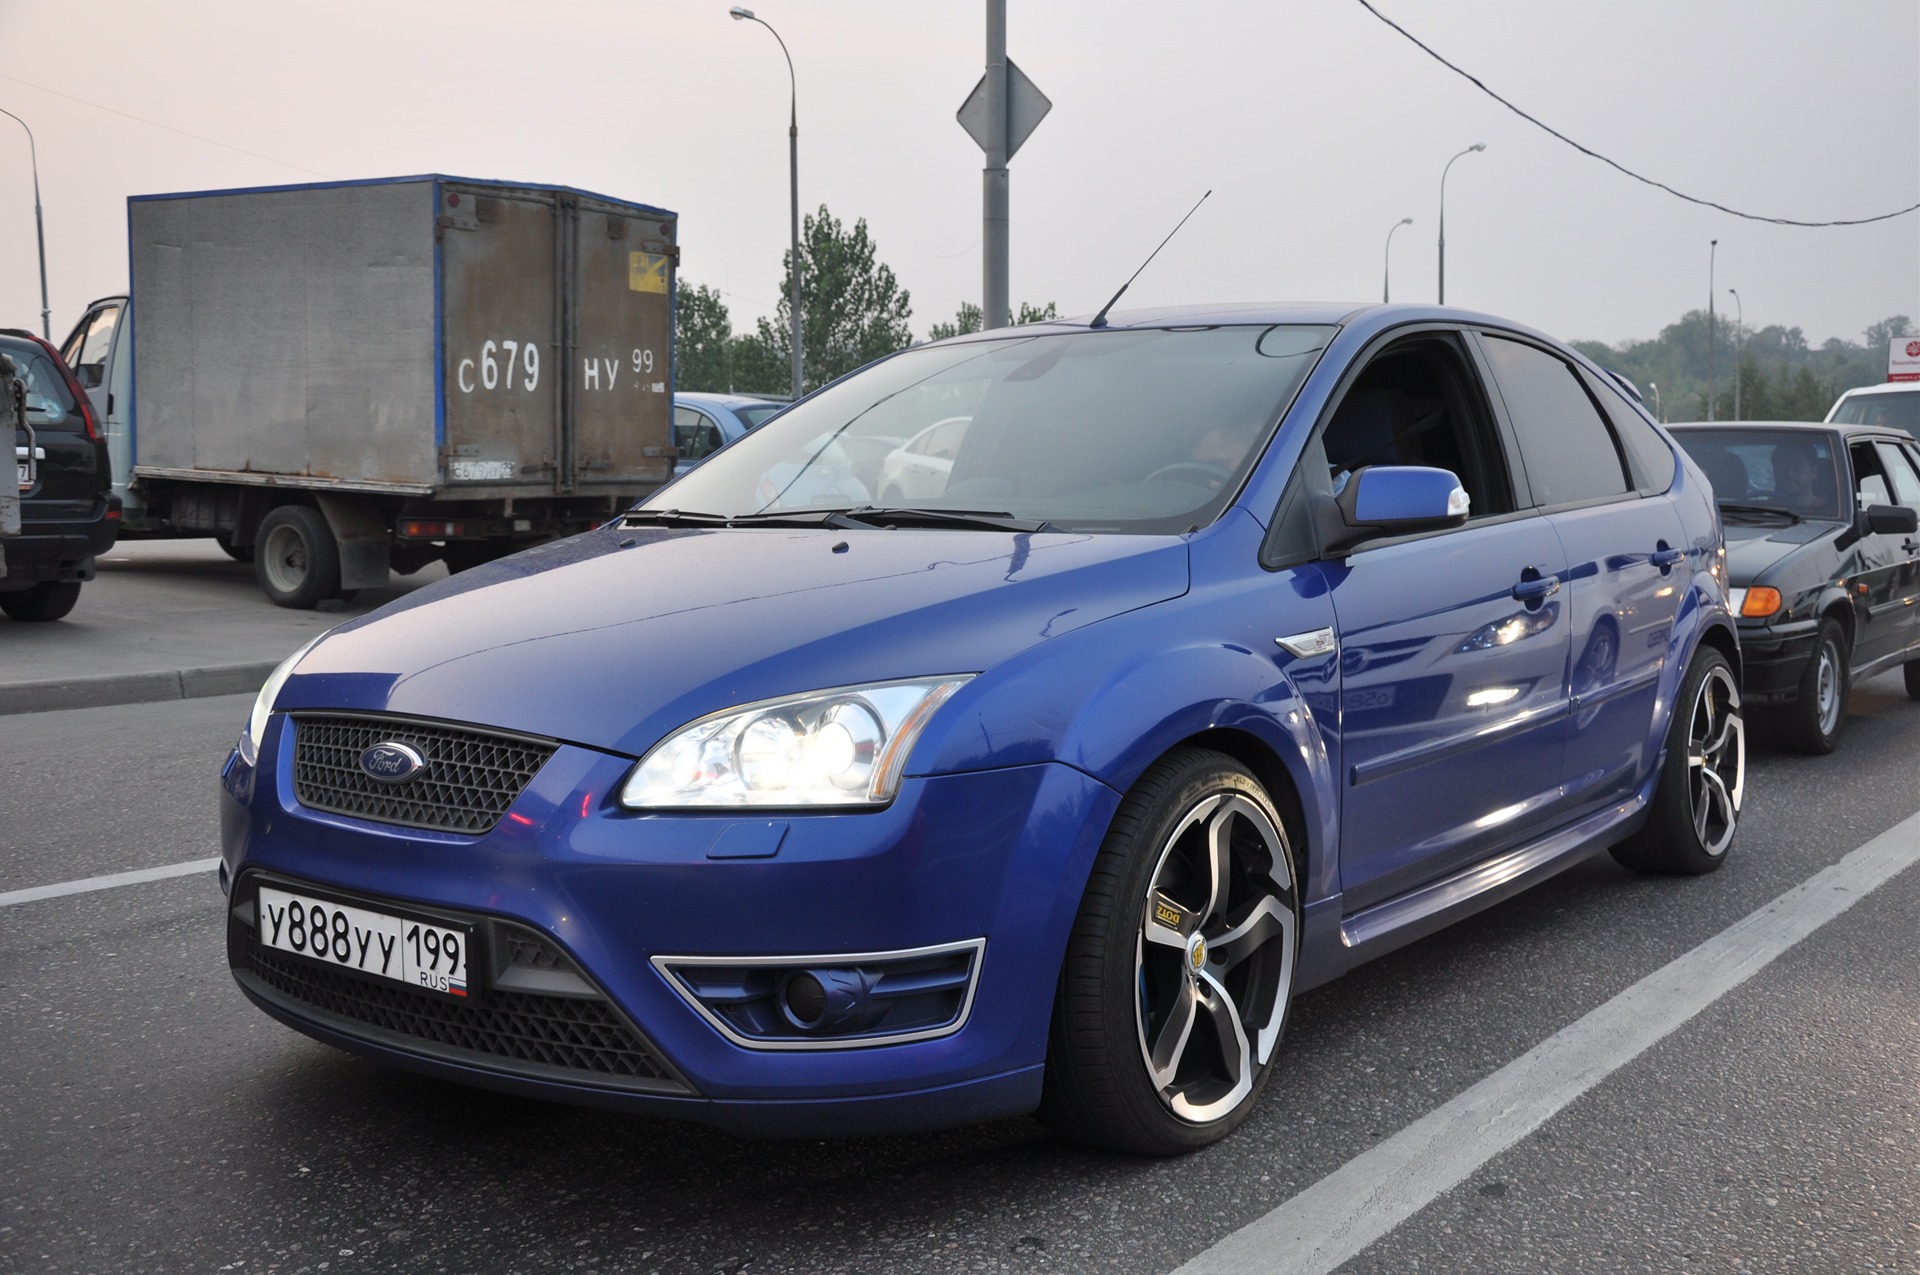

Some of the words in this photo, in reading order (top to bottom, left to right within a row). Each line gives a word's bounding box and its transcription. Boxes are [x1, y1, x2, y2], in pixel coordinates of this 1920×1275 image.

[632, 348, 654, 373] 99
[369, 749, 403, 773] Ford
[1156, 905, 1180, 924] DOTZ
[406, 925, 460, 976] 199
[420, 971, 448, 991] RUS
